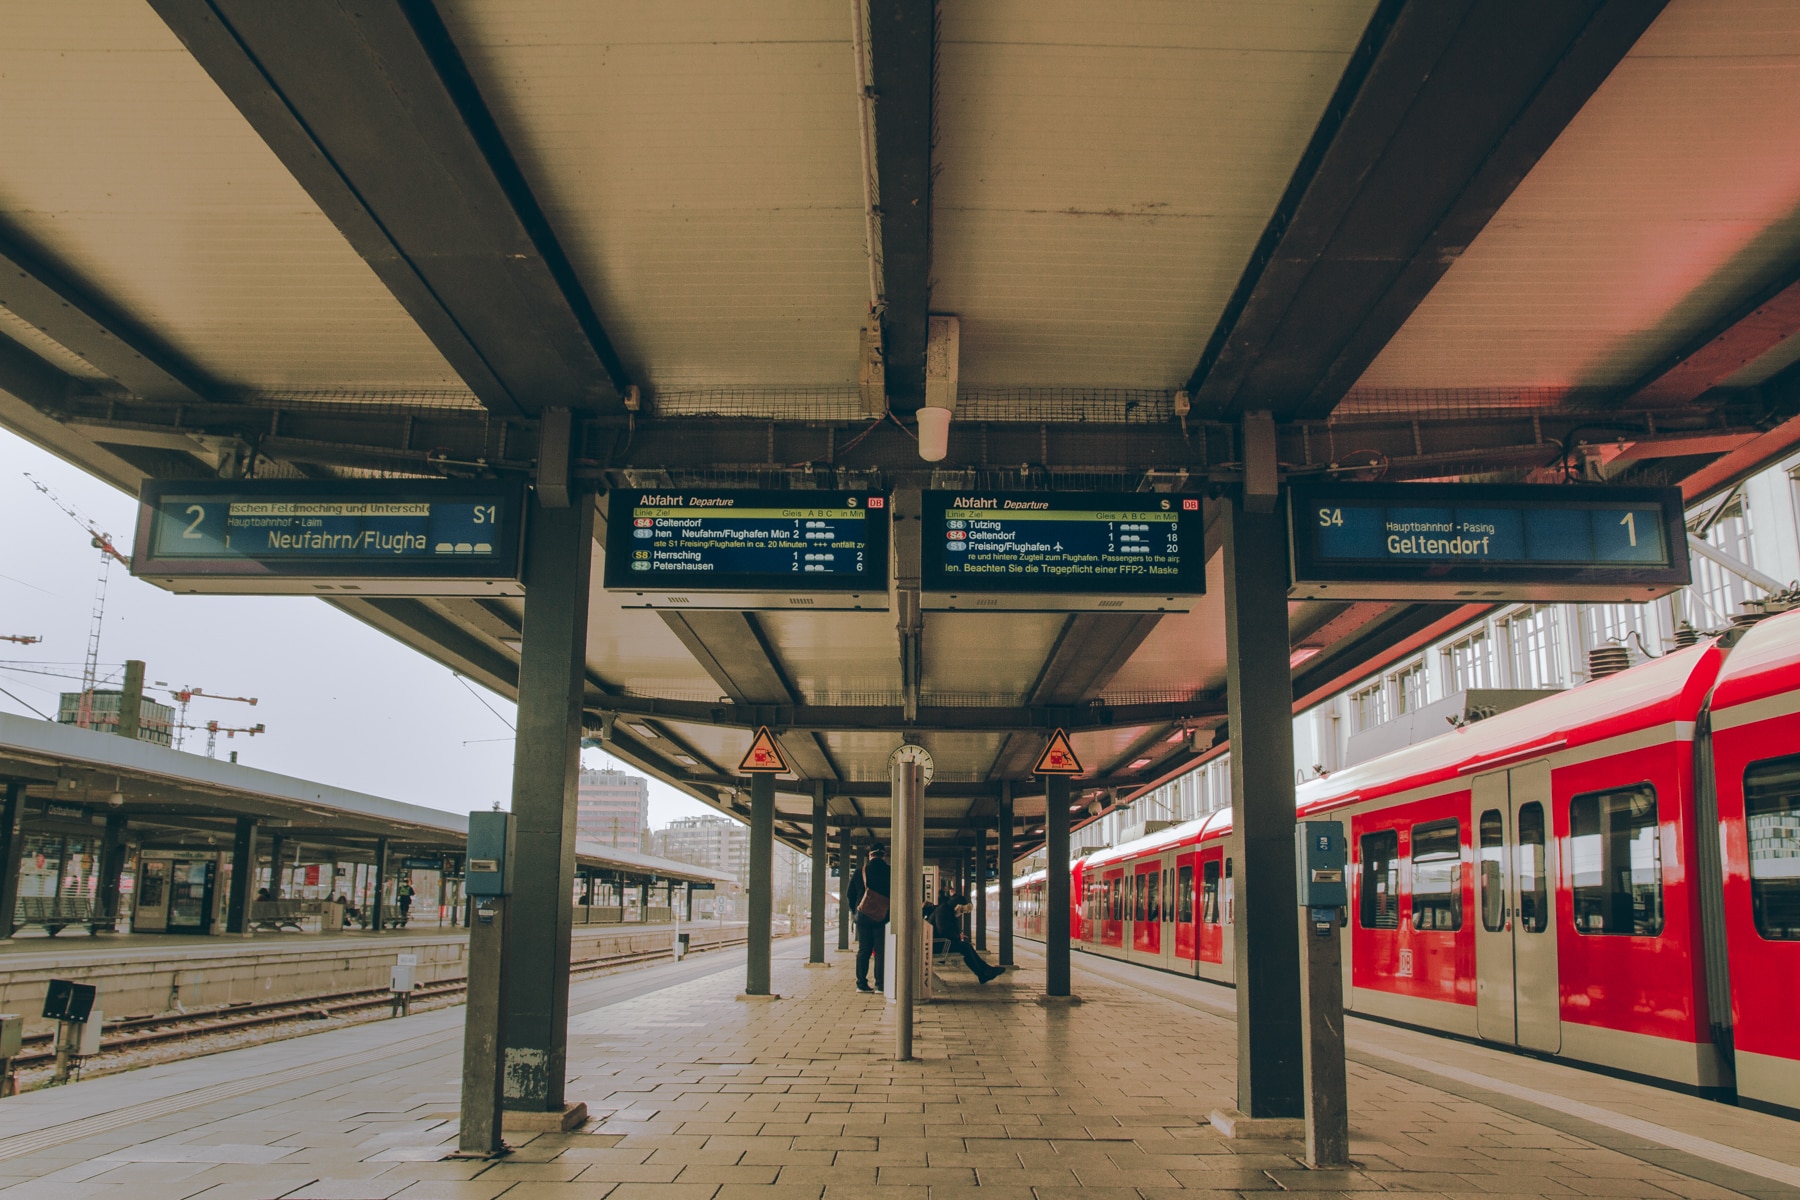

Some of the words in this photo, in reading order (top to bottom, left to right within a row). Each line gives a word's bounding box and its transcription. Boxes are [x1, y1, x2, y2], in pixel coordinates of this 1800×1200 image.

[640, 495, 683, 506] Abfahrt
[689, 497, 734, 507] Departure
[848, 498, 857, 507] S
[869, 498, 882, 507] DB
[954, 497, 997, 508] Abfahrt
[1004, 500, 1048, 510] Departure
[1161, 500, 1170, 510] S
[1184, 500, 1197, 509] DB
[272, 504, 342, 514] Feldmoching
[346, 504, 366, 513] und
[473, 505, 496, 524] S1
[1319, 508, 1344, 526] S4
[182, 505, 204, 539] 2
[228, 517, 292, 528] Hauptbahnhof
[302, 518, 322, 527] Laim
[656, 519, 702, 527] Geltendorf
[969, 520, 1001, 530] Tutzing
[1108, 522, 1113, 530] 1
[1171, 523, 1178, 531] 9
[1386, 522, 1453, 533] Hauptbahnhof
[1464, 523, 1495, 535] Pasing
[1620, 512, 1636, 546] 1
[655, 529, 672, 538] hen
[682, 529, 768, 540] Neufahrn/Flughafen
[771, 529, 790, 538] Mün
[793, 530, 799, 538] 2
[969, 531, 1016, 540] Geltendorf
[1108, 533, 1113, 541] 1
[1166, 534, 1178, 542] 18
[268, 530, 426, 554] Neufahrn/Flugha
[680, 540, 745, 549] Freising/Flughafen
[1387, 535, 1490, 554] Geltendorf
[968, 542, 1050, 552] Freising/Flughafen
[1108, 544, 1114, 552] 2
[1166, 544, 1178, 553] 20
[654, 551, 701, 560] Herrsching
[857, 552, 863, 560] 2
[1020, 554, 1043, 562] Zugteil
[1102, 555, 1144, 563] Passengers
[654, 561, 714, 570] Petershausen
[792, 563, 798, 571] 2
[856, 563, 863, 571] 6
[964, 564, 1006, 572] Beachten
[1008, 564, 1023, 573] Sie
[1025, 564, 1038, 573] die
[1041, 564, 1093, 574] Tragepflicht
[1095, 565, 1117, 574] einer
[1150, 566, 1178, 574] Maske
[1401, 951, 1412, 974] DB
